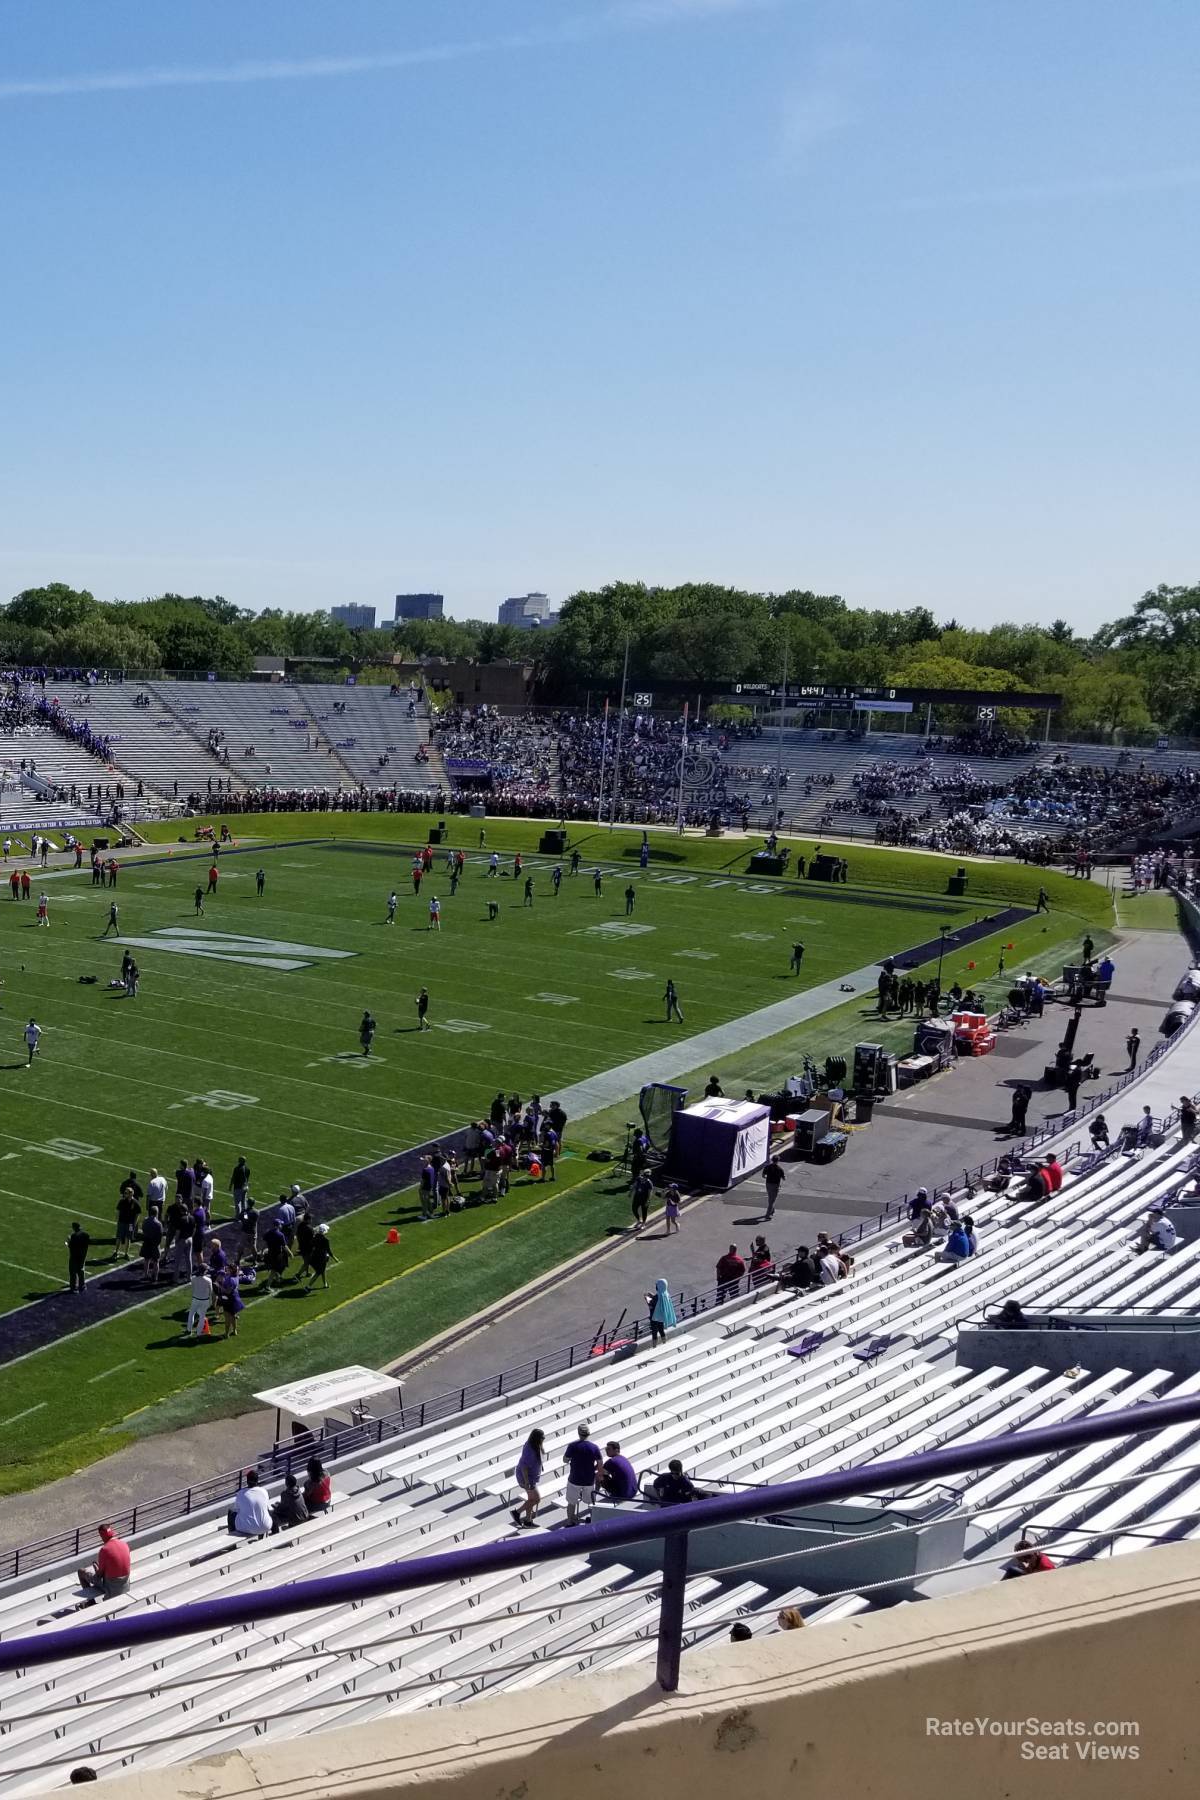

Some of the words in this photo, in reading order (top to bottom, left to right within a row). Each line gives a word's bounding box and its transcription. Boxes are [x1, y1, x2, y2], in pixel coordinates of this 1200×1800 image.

[801, 686, 824, 695] 64:41
[636, 695, 650, 705] 25
[979, 707, 993, 719] 25
[184, 1089, 260, 1111] 20
[22, 1137, 104, 1160] 10
[295, 1381, 330, 1397] SPORTS
